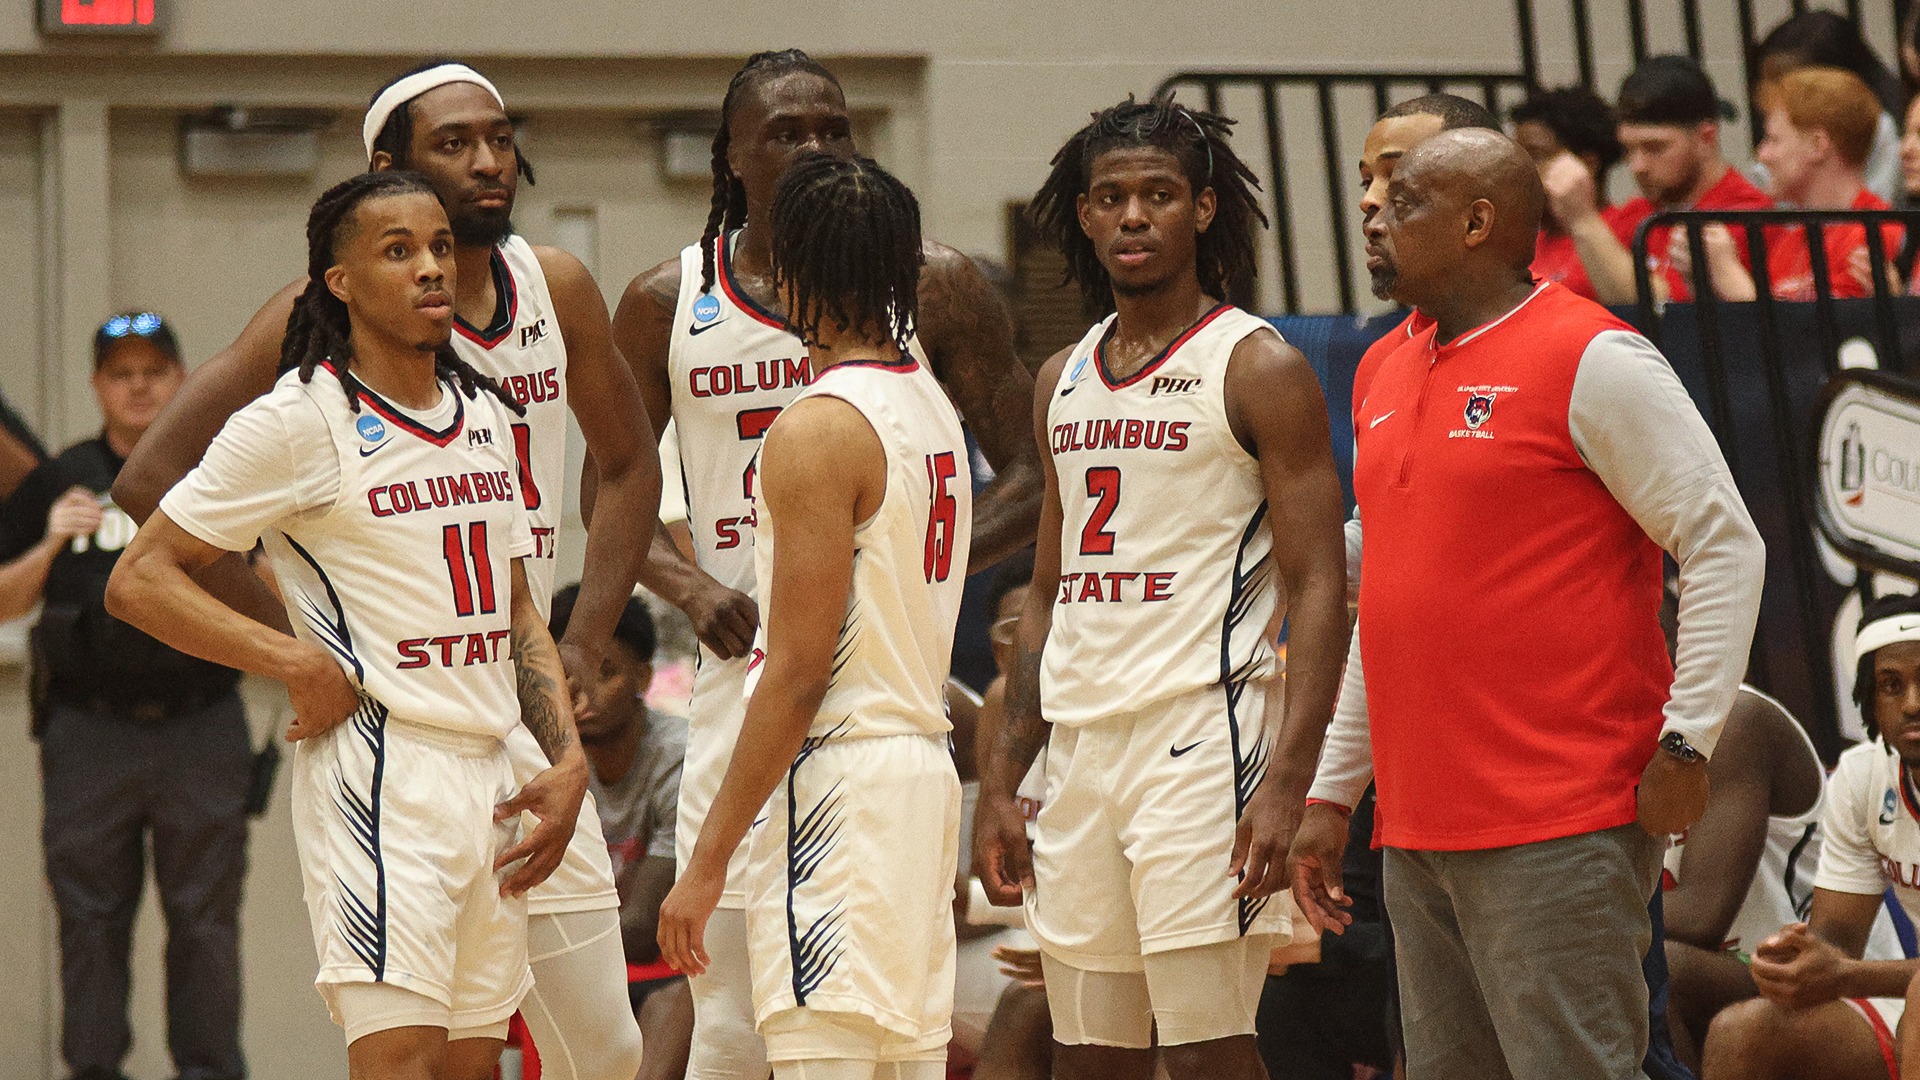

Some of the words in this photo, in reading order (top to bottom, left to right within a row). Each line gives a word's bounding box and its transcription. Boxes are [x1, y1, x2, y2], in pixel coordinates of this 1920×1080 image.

[1150, 377, 1201, 395] PBC
[363, 423, 384, 437] NCAA
[1053, 419, 1192, 455] COLUMBUS
[1448, 430, 1495, 439] BASKETBALL
[367, 470, 514, 518] COLUMBUS
[1079, 466, 1122, 555] 2
[442, 520, 497, 618] 11
[396, 629, 515, 669] STAT
